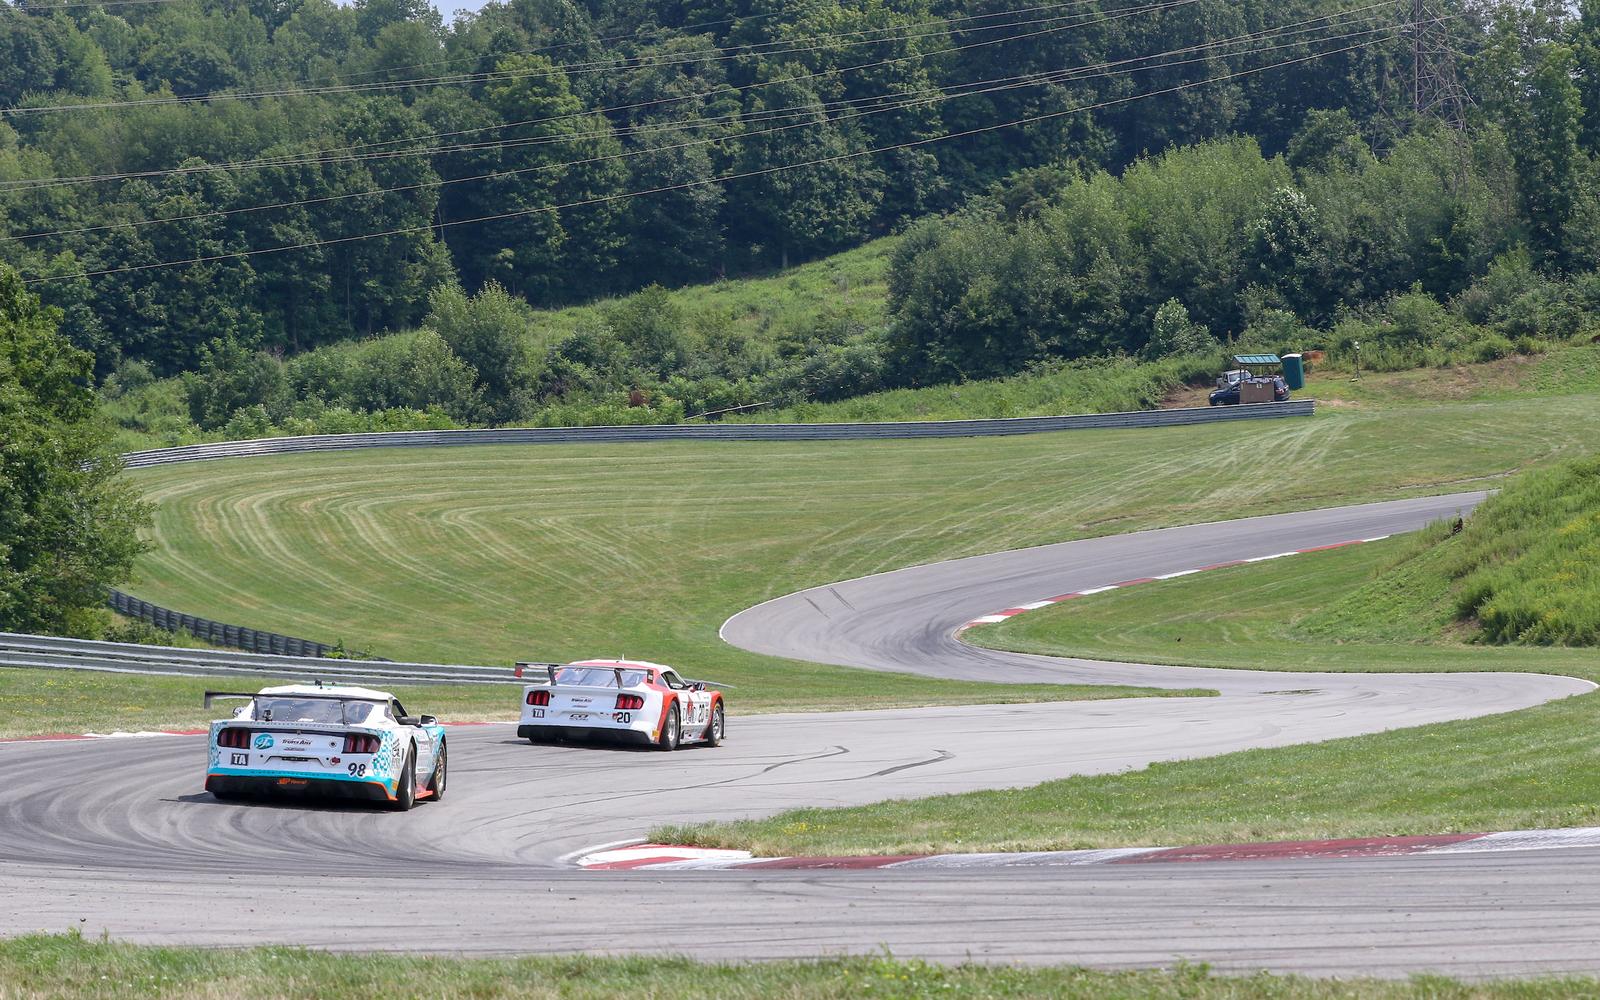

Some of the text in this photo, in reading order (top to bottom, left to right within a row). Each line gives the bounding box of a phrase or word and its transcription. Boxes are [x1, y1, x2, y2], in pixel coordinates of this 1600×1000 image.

[617, 711, 631, 724] 20
[698, 703, 705, 723] 20
[232, 753, 247, 766] TA
[347, 762, 367, 777] 98
